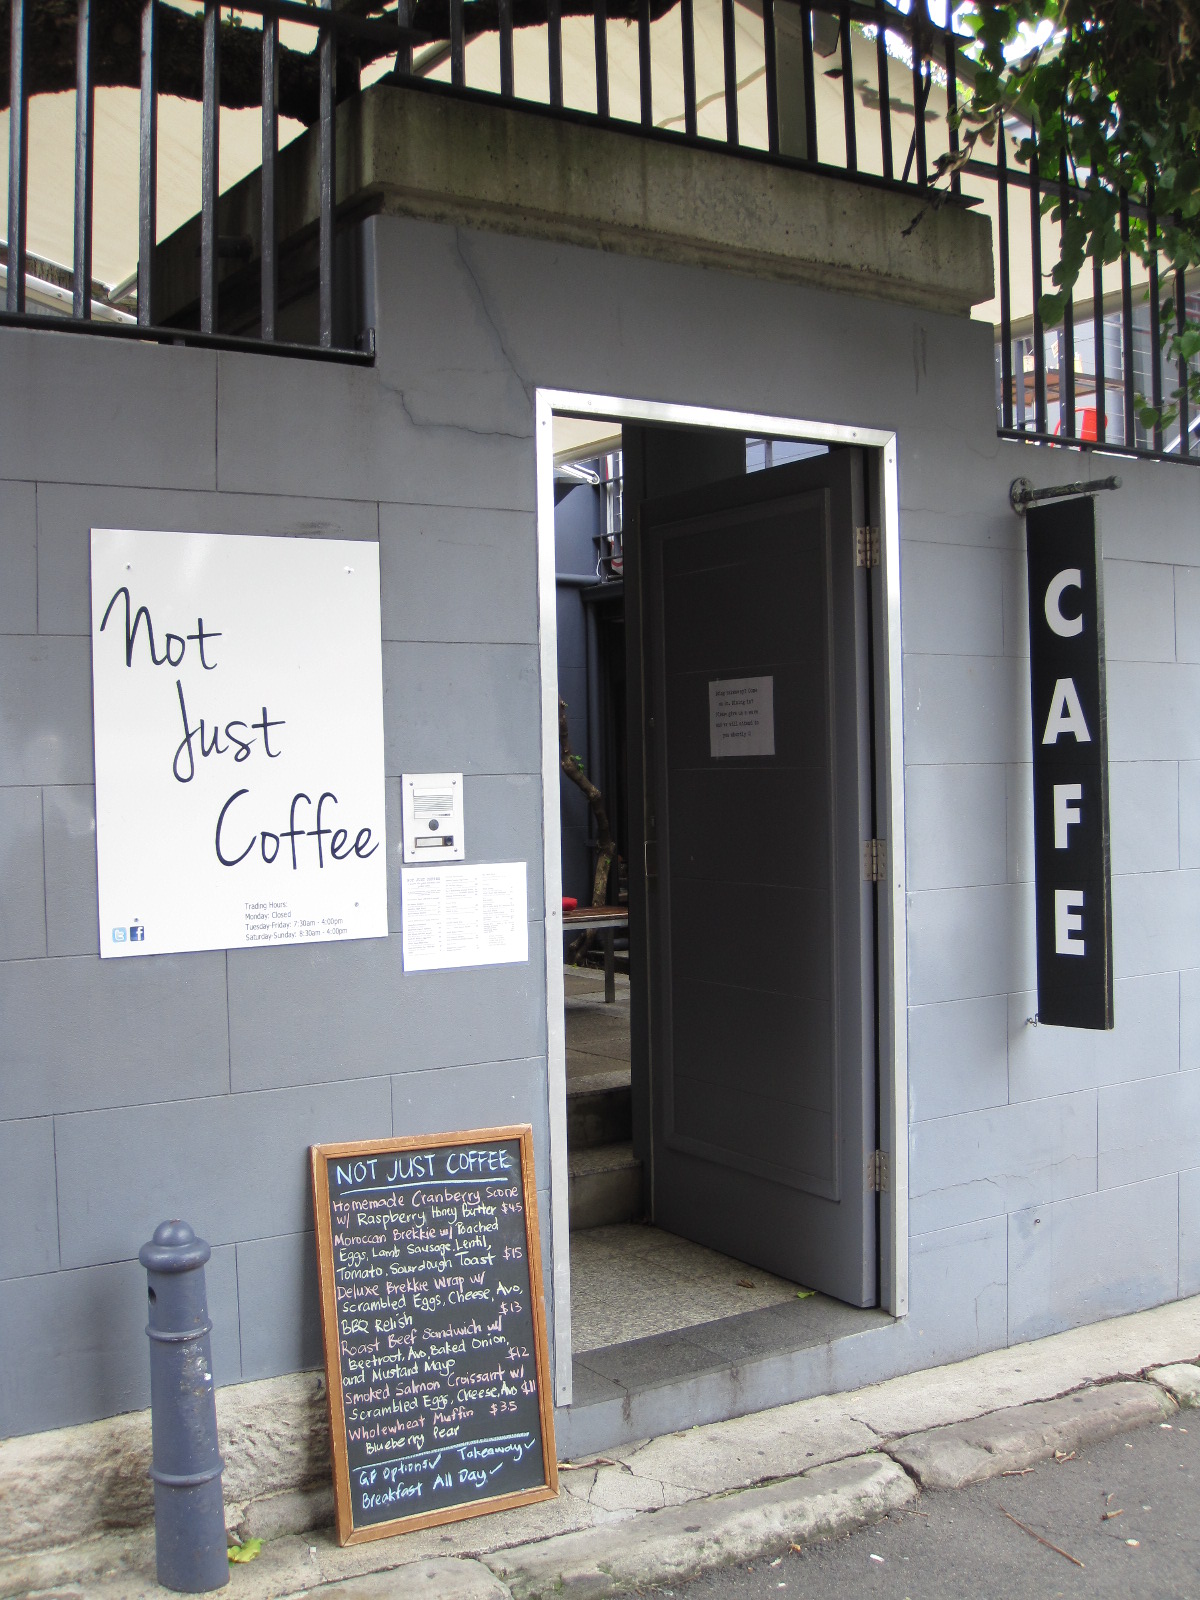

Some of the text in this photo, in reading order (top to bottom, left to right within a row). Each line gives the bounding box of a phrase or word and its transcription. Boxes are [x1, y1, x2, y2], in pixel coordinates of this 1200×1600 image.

[99, 586, 222, 670] Not
[172, 680, 286, 783] Just
[1041, 567, 1092, 956] CAFE
[215, 789, 379, 870] Coffee
[336, 1149, 512, 1185] NOT JUST COFFEE
[333, 1186, 519, 1213] Homemade Cranberry Scone
[337, 1213, 349, 1228] w/
[357, 1211, 425, 1230] Raspberry
[431, 1205, 457, 1224] Honey
[462, 1202, 497, 1218] Butter
[334, 1233, 386, 1246] Moroccan
[393, 1227, 436, 1241] Brekkie
[457, 1217, 499, 1235] Poached
[372, 1244, 400, 1258] Lamb
[390, 1258, 452, 1275] Sourdough
[454, 1251, 496, 1267] Toast
[503, 1246, 523, 1261] $15
[337, 1284, 379, 1300] Deluxe
[386, 1278, 429, 1294] Brekkie
[434, 1275, 465, 1293] Wrap
[343, 1297, 407, 1313] Scrambled
[499, 1301, 523, 1315] $13
[341, 1312, 413, 1335] BBQ Relish
[341, 1338, 380, 1356] Roast
[388, 1331, 418, 1348] Beef
[422, 1322, 482, 1341] Sandwich
[430, 1341, 466, 1358] Baked
[505, 1346, 530, 1361] $12
[342, 1358, 455, 1386] and Mustard Mayo
[345, 1385, 390, 1405] Smoked
[396, 1380, 440, 1397] Salmon
[448, 1363, 505, 1387] Croissant
[348, 1415, 425, 1441] Wholewheat
[433, 1406, 474, 1425] Muffin
[349, 1400, 419, 1421] Scrambled
[366, 1424, 460, 1455] Blueberry Pear
[457, 1443, 523, 1461] Takeaway
[362, 1468, 487, 1509] Breakfast All Day
